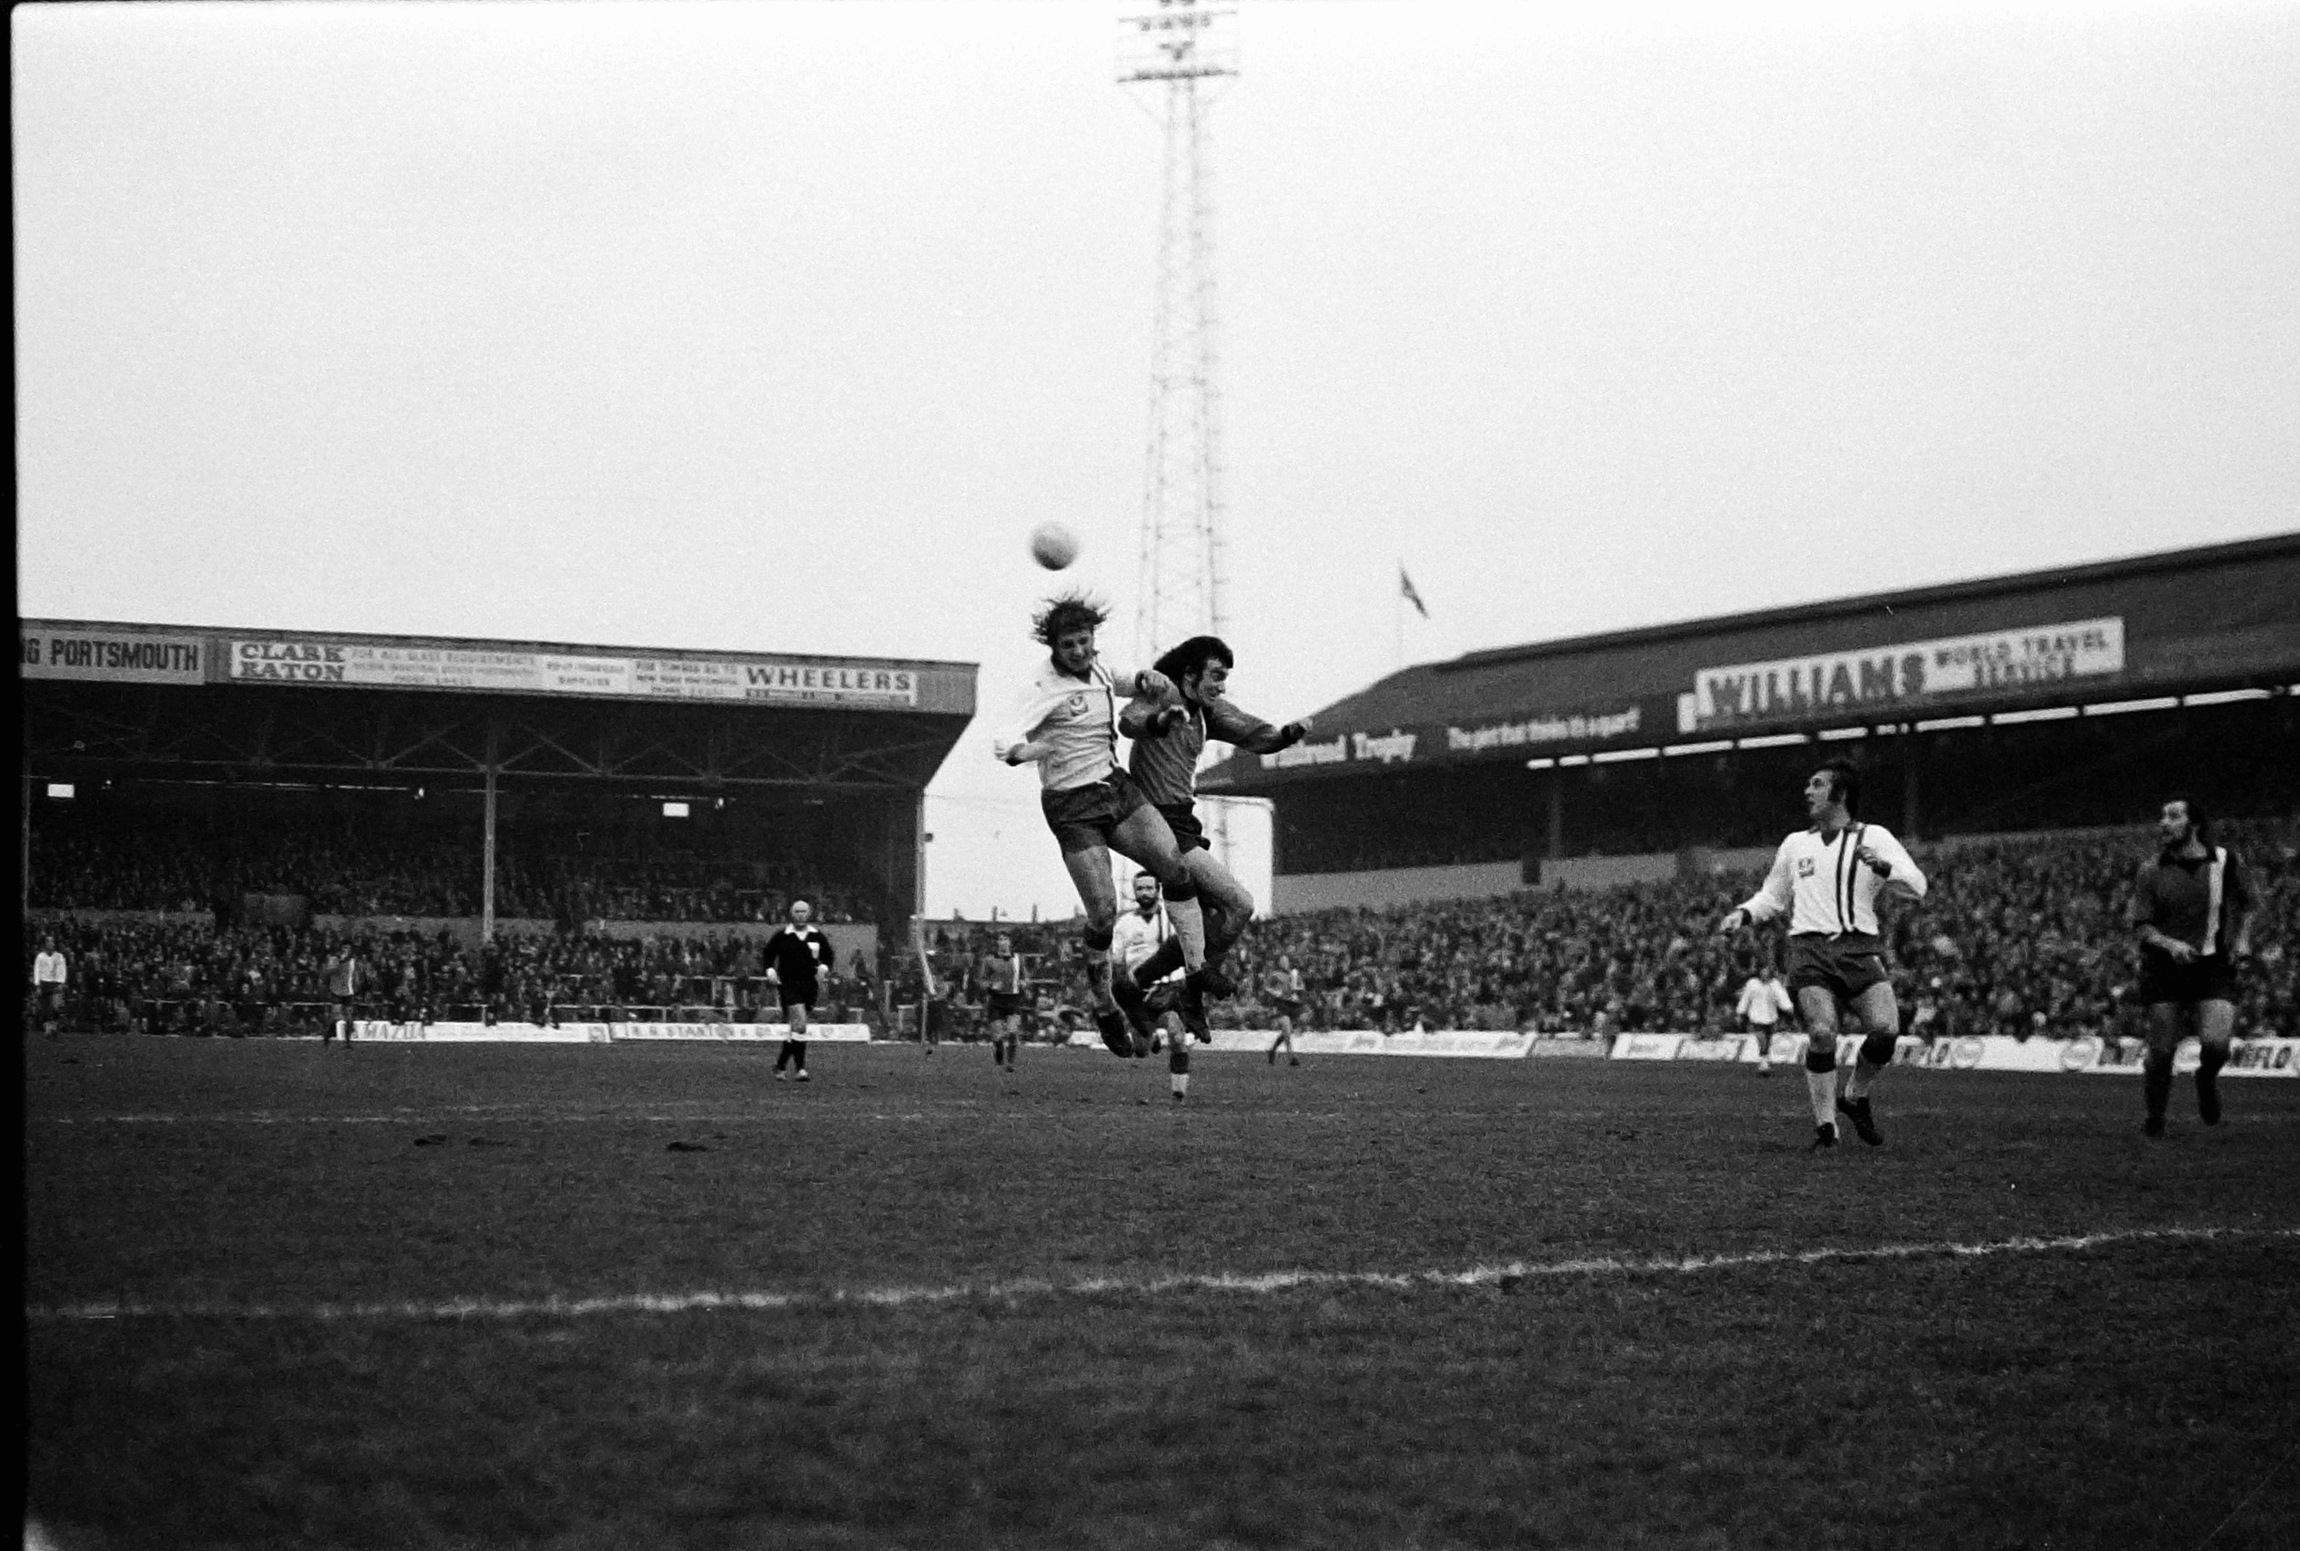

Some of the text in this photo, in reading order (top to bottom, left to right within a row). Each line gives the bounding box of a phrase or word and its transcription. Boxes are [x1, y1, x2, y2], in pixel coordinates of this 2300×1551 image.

[52, 639, 198, 671] PORTSMOUTH
[241, 643, 344, 661] CLARK
[747, 667, 910, 690] WHEELERS
